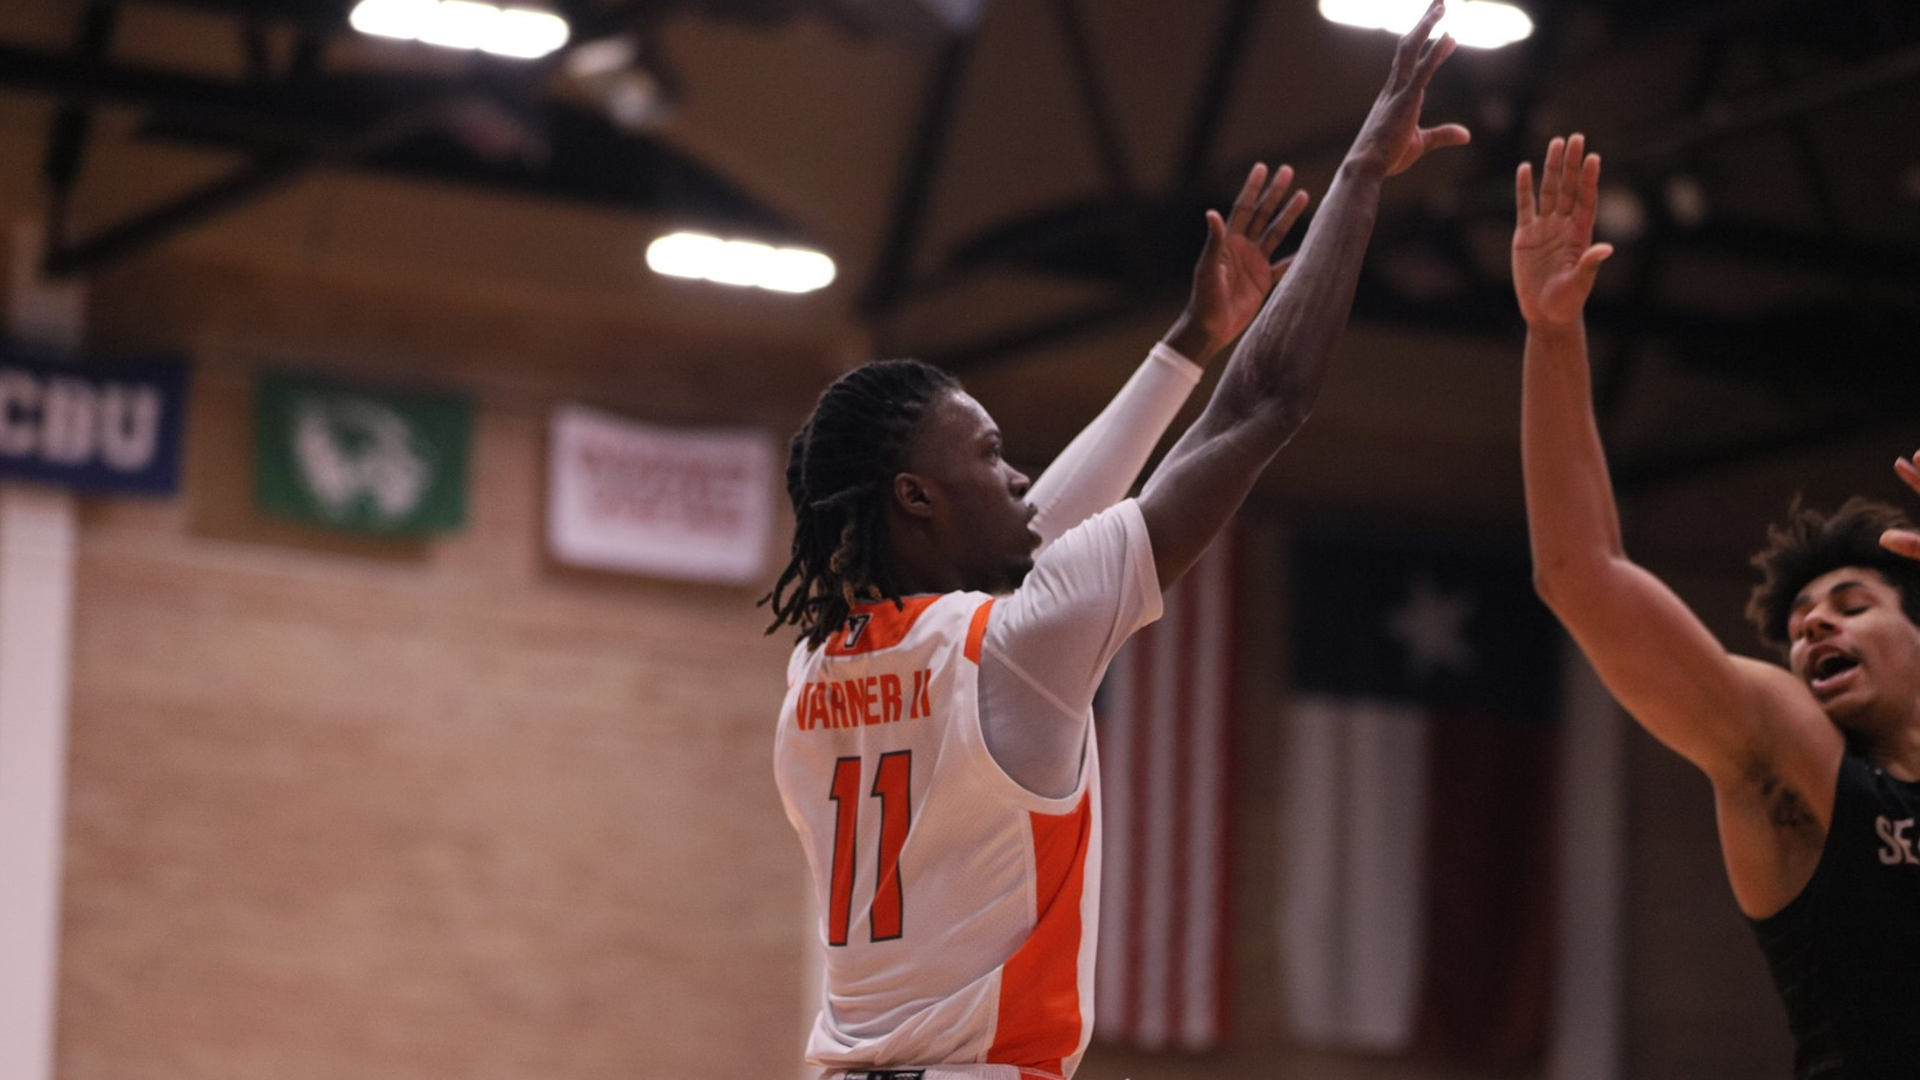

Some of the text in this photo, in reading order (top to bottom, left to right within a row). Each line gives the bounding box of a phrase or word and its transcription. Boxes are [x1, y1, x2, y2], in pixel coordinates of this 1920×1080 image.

[796, 668, 931, 731] VARNER II
[829, 749, 911, 947] 11
[1875, 815, 1920, 865] SE
